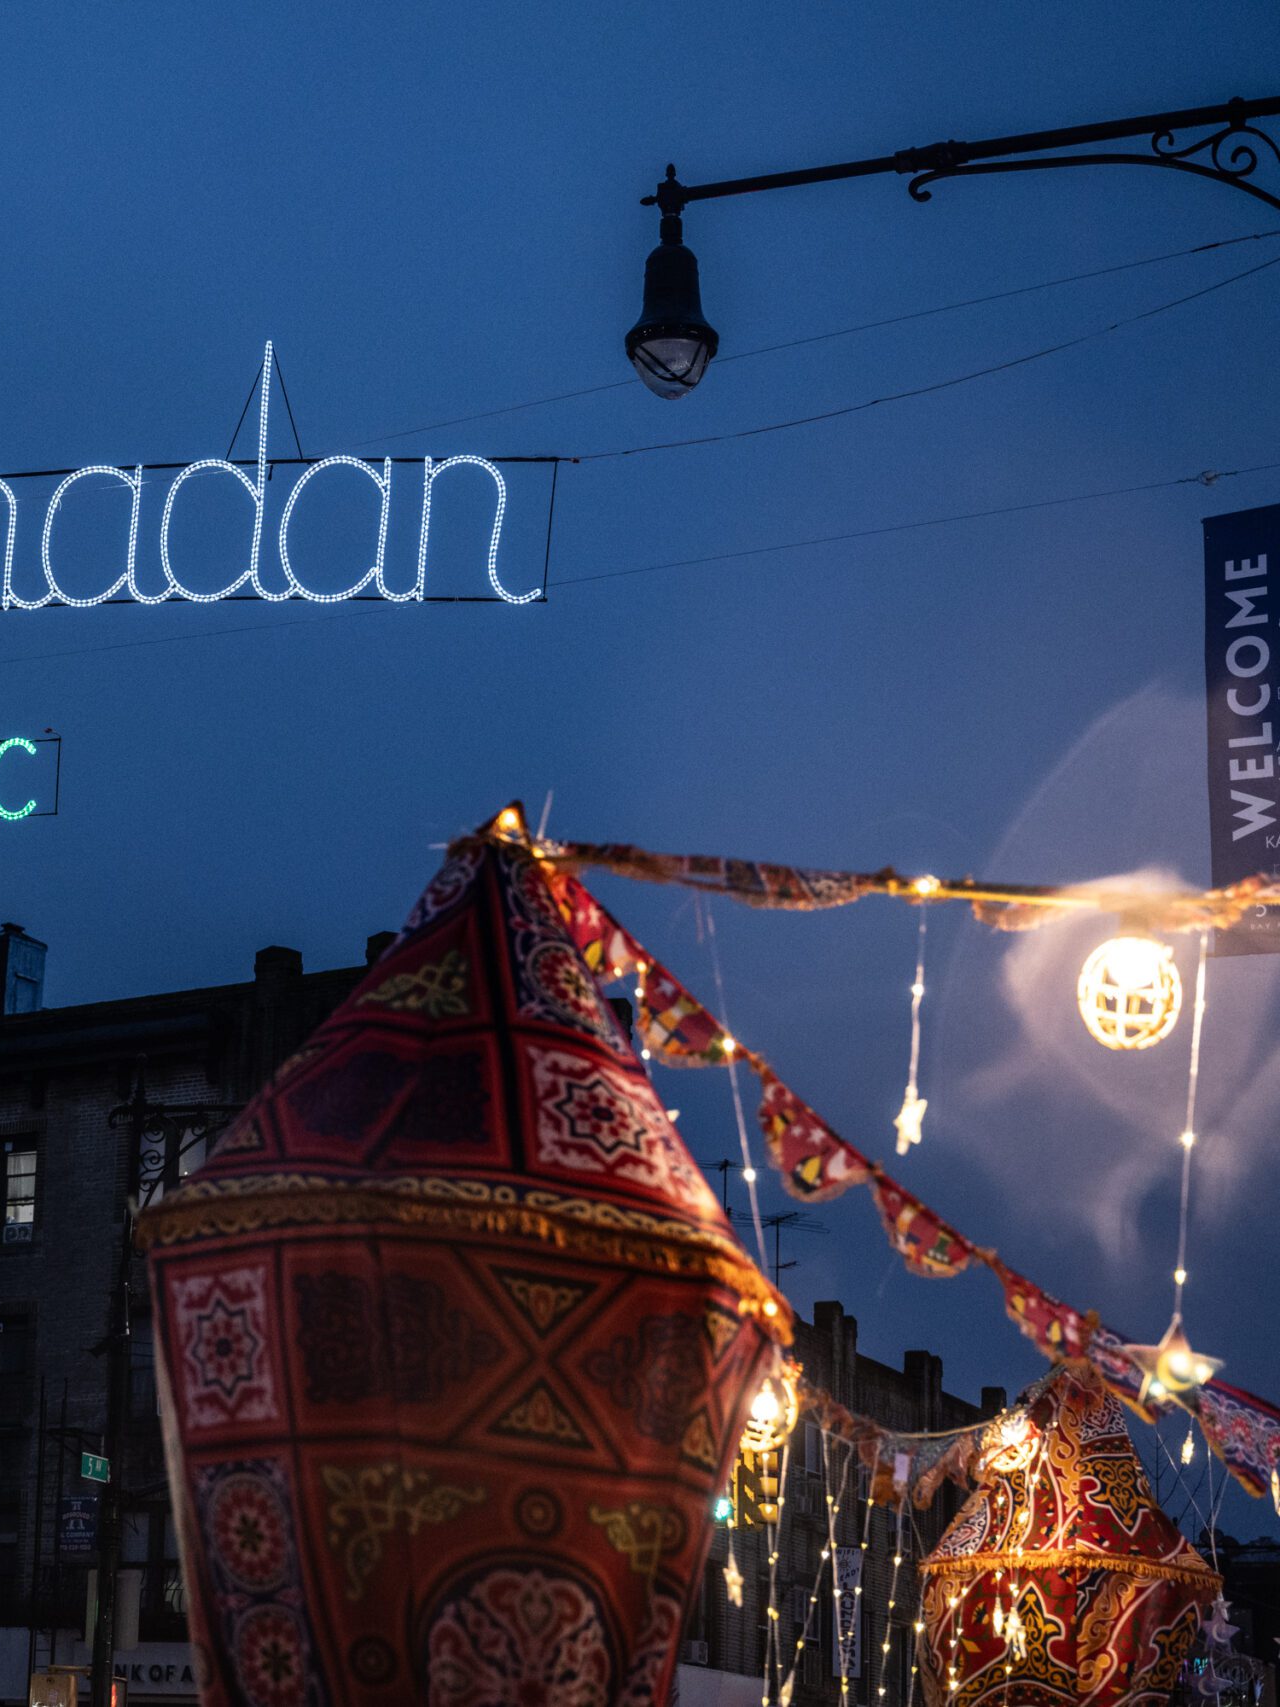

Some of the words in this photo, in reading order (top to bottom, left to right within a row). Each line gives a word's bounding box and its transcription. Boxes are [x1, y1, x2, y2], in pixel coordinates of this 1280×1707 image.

[1224, 553, 1277, 842] WELCOME
[88, 1456, 93, 1475] 5
[149, 1664, 176, 1682] OF
